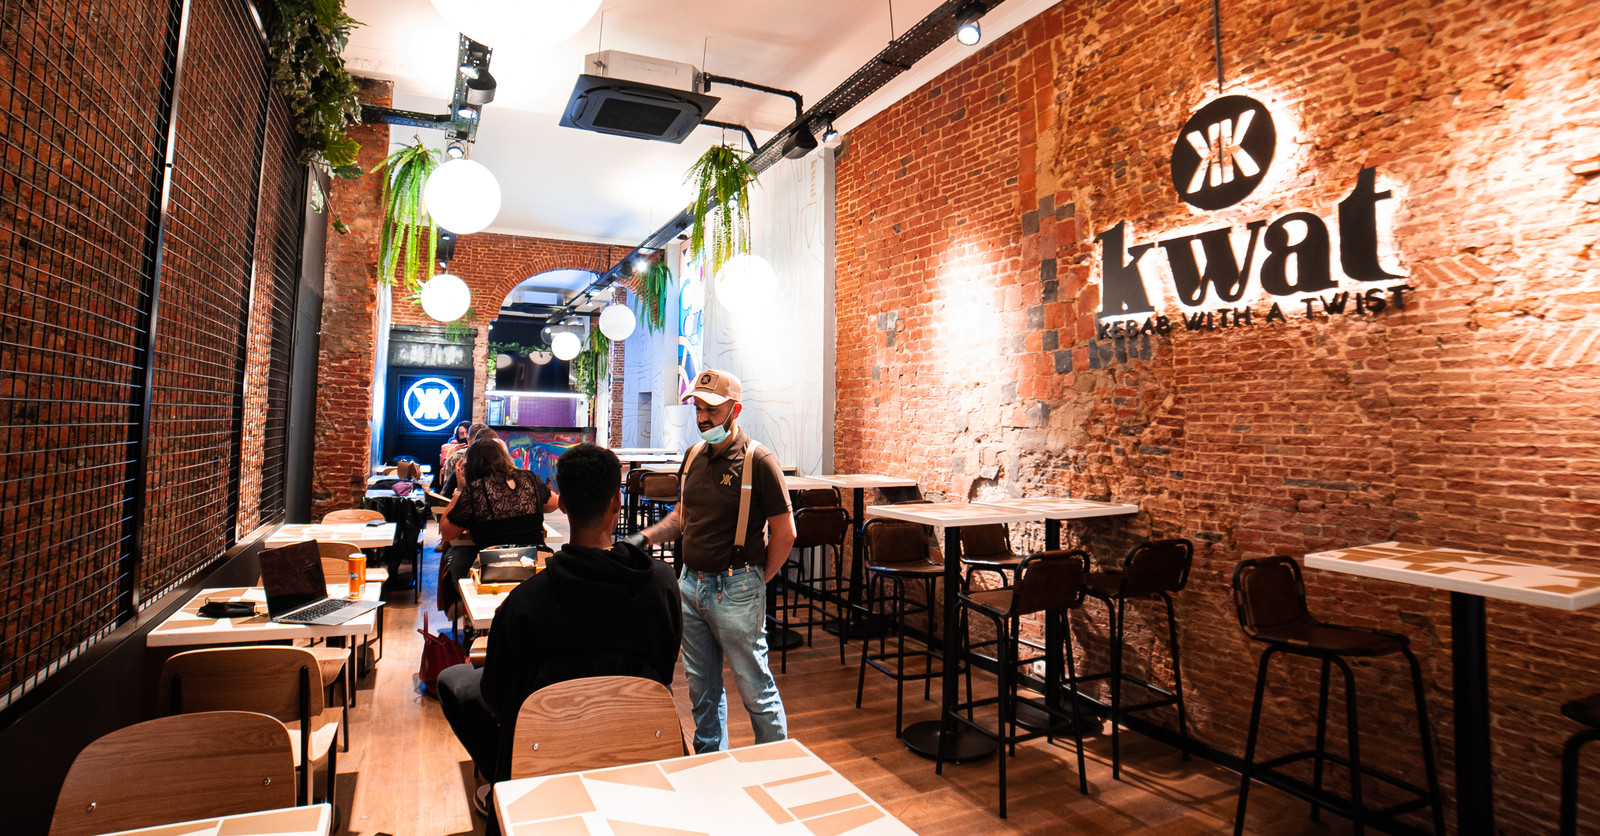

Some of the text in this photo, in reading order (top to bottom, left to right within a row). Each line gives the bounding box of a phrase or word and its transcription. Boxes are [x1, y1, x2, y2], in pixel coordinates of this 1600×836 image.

[1095, 166, 1410, 316] kwat
[1097, 285, 1415, 340] KEBAB WITH A TWIST
